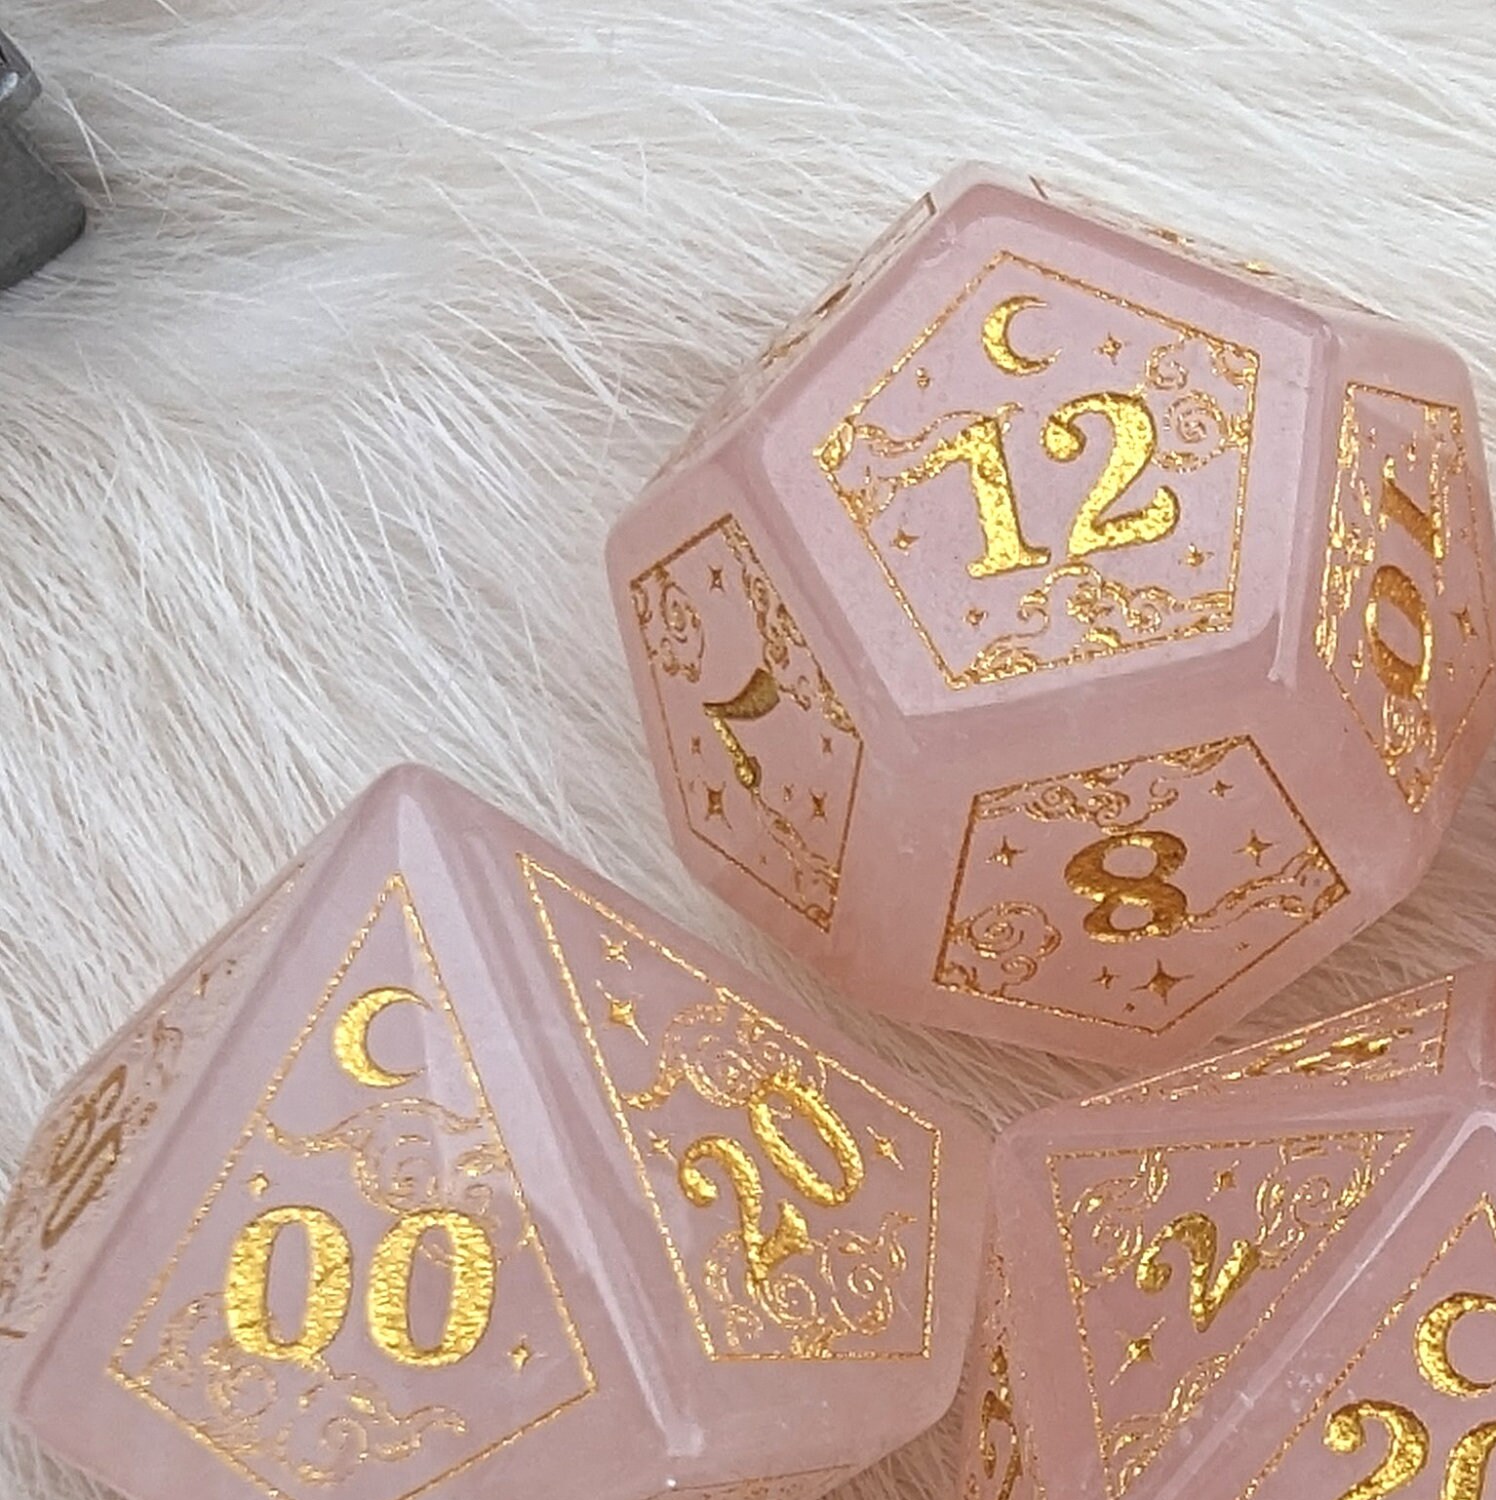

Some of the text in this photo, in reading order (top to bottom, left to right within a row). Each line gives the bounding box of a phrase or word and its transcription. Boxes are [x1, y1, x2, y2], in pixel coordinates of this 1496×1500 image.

[918, 391, 1180, 578] 12
[1365, 455, 1446, 700] 10
[1064, 829, 1191, 944] 8
[679, 1074, 864, 1282] 20
[224, 1204, 498, 1368] 00
[1136, 1211, 1261, 1333] 2
